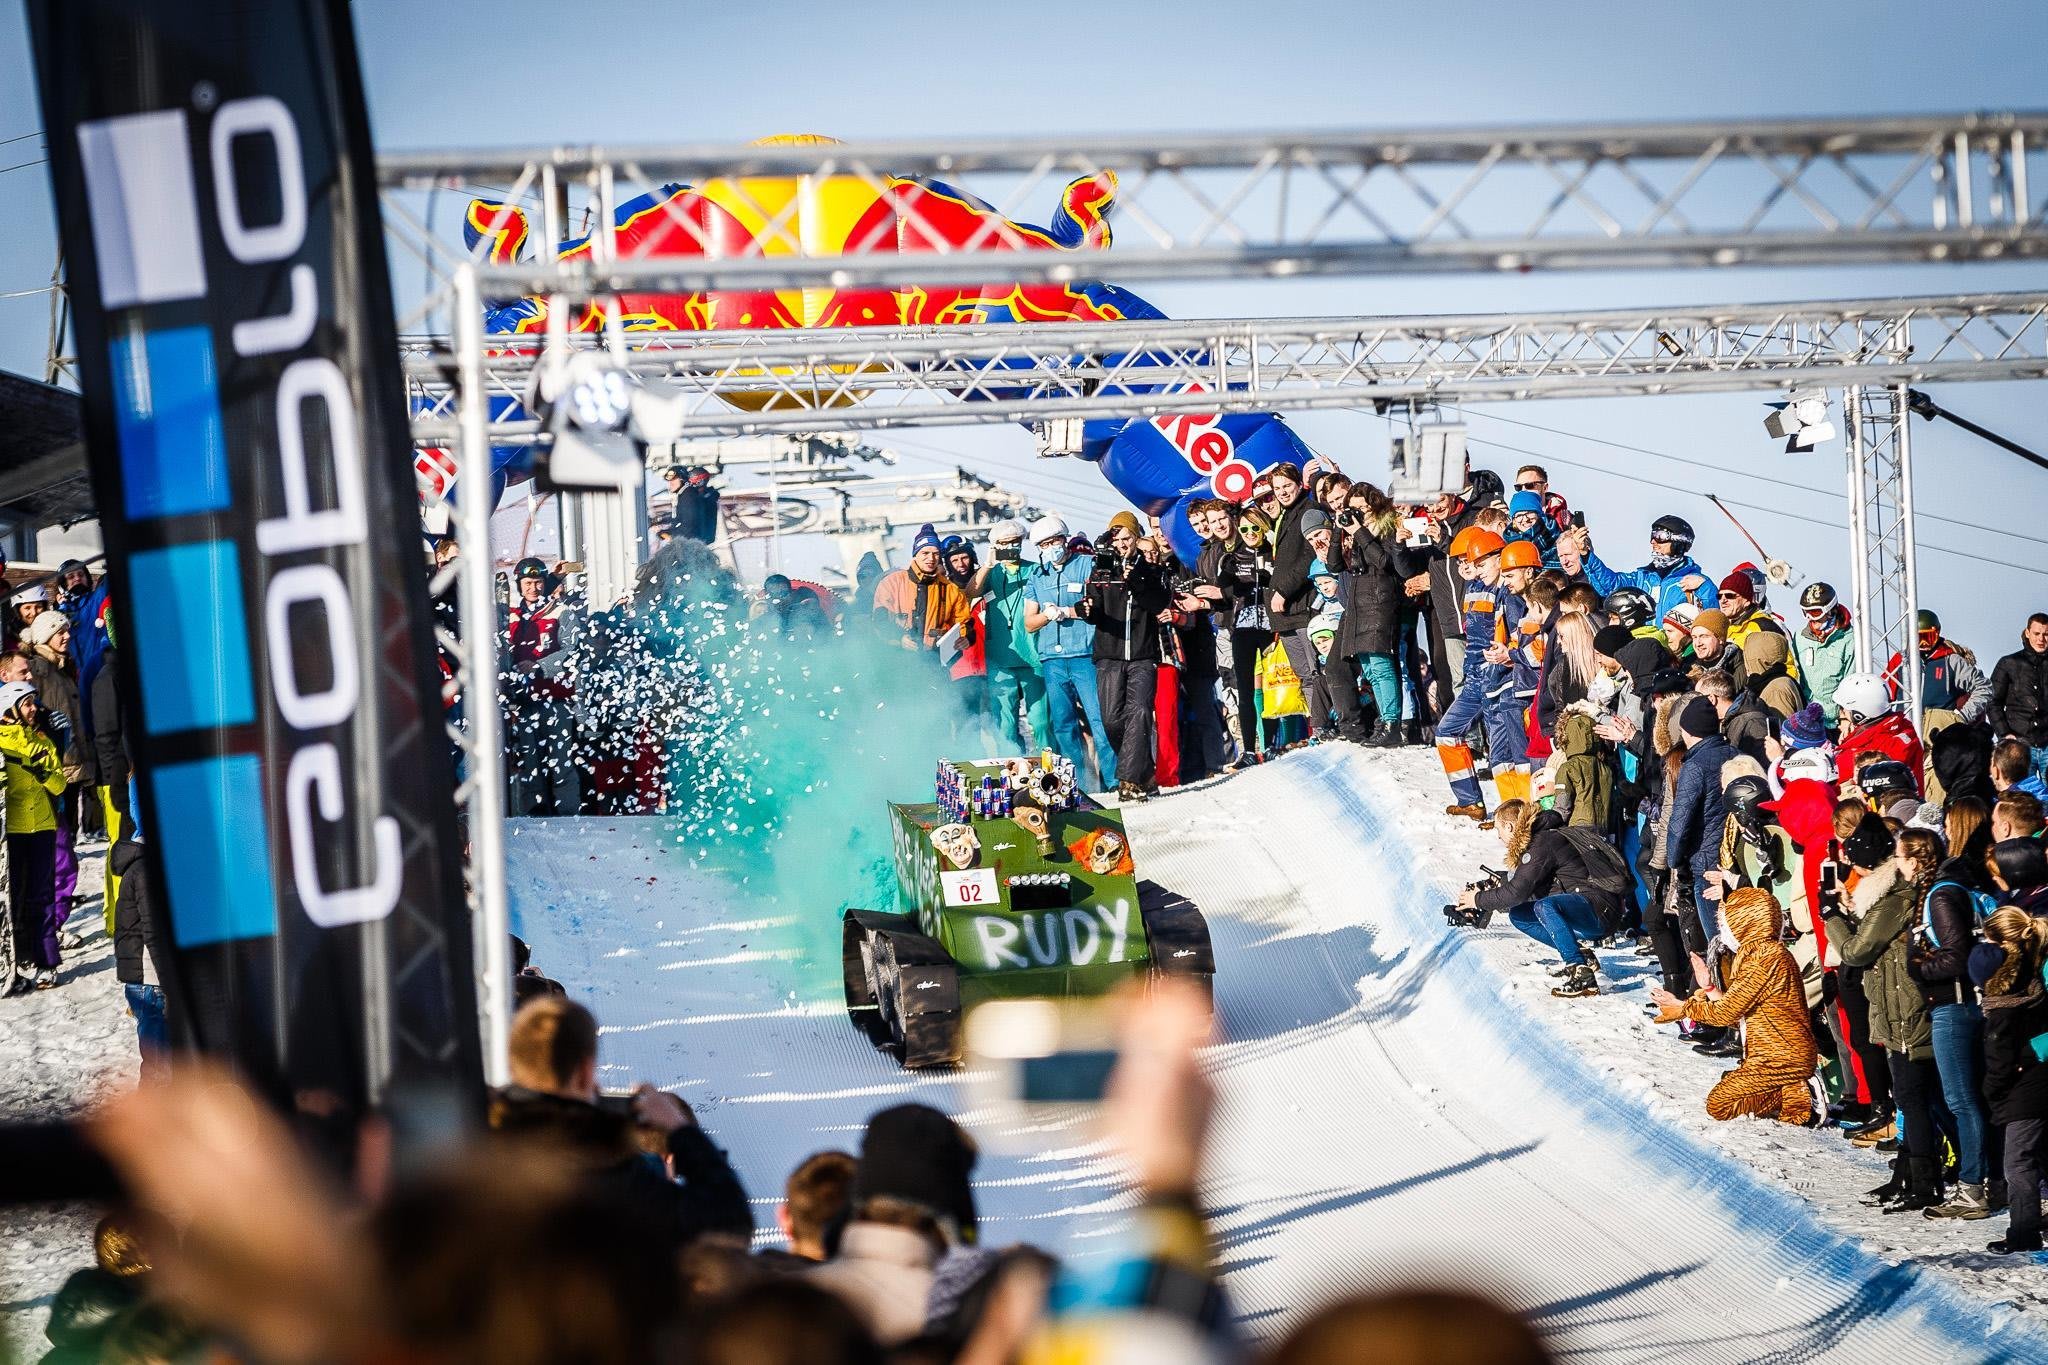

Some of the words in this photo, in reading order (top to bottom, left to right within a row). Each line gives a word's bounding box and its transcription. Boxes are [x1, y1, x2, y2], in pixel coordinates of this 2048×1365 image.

[1862, 777, 1891, 787] uvex
[959, 884, 983, 902] 02
[974, 899, 1129, 969] RUDY
